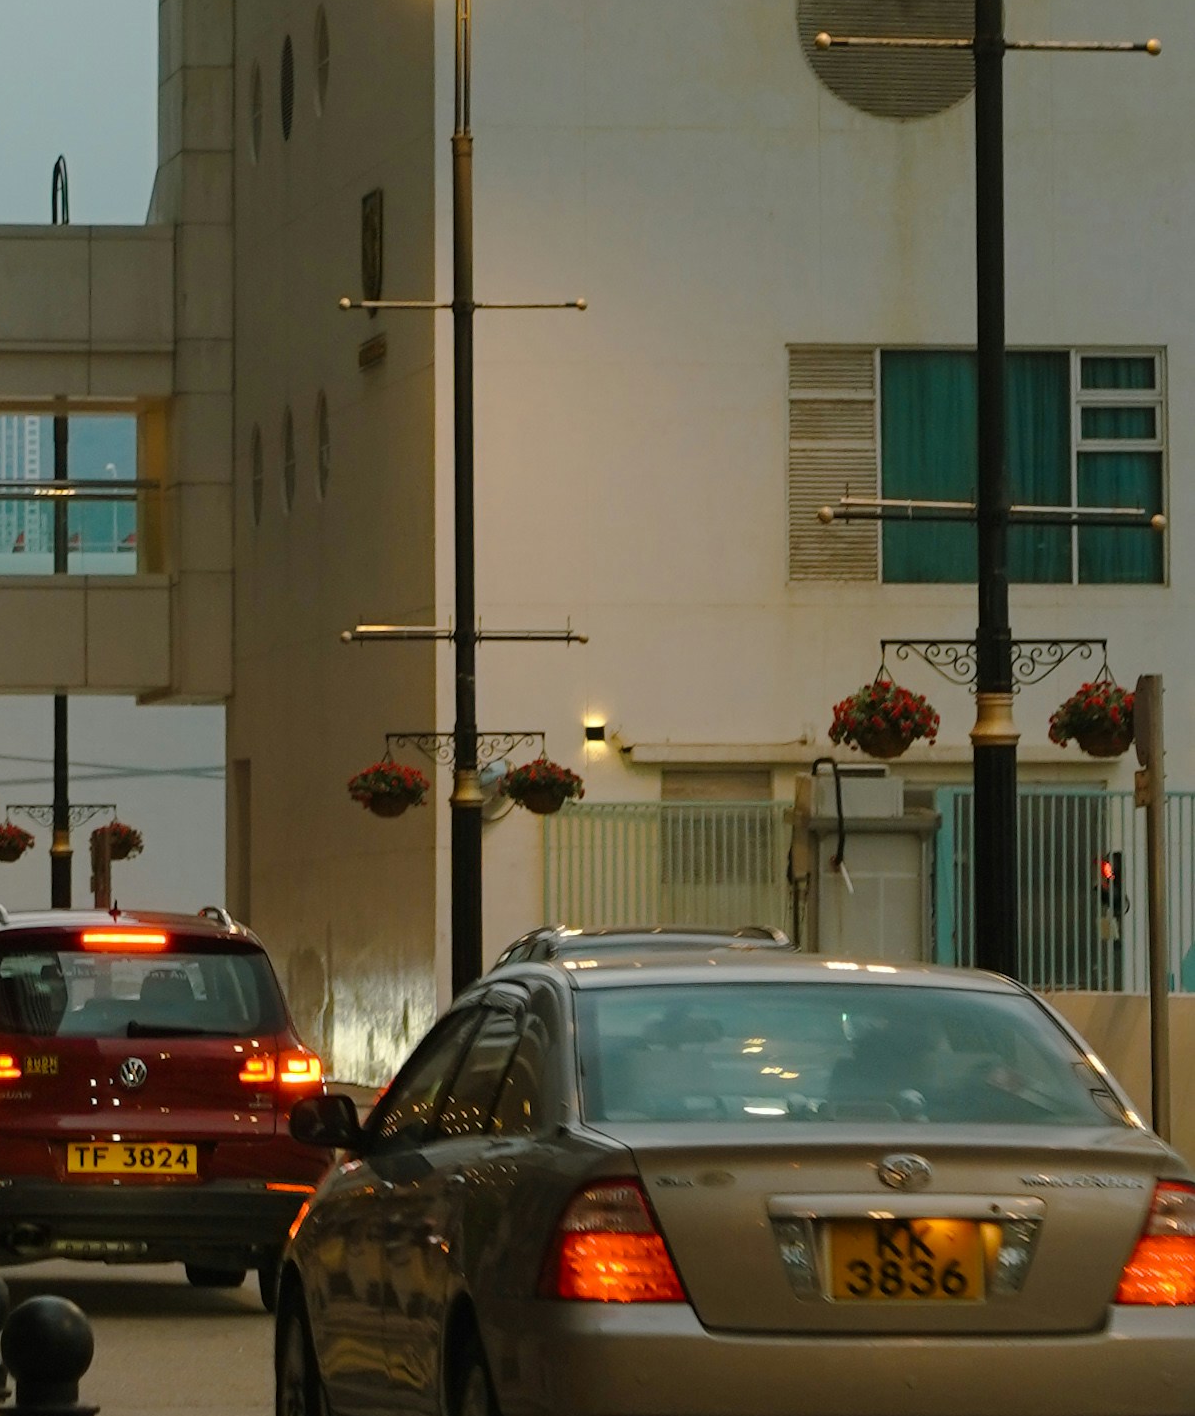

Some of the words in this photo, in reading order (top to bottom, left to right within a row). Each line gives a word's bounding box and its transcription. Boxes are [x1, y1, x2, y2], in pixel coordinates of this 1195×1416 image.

[74, 1147, 109, 1169] TF
[122, 1147, 190, 1169] 3824
[846, 1259, 968, 1298] 3836
